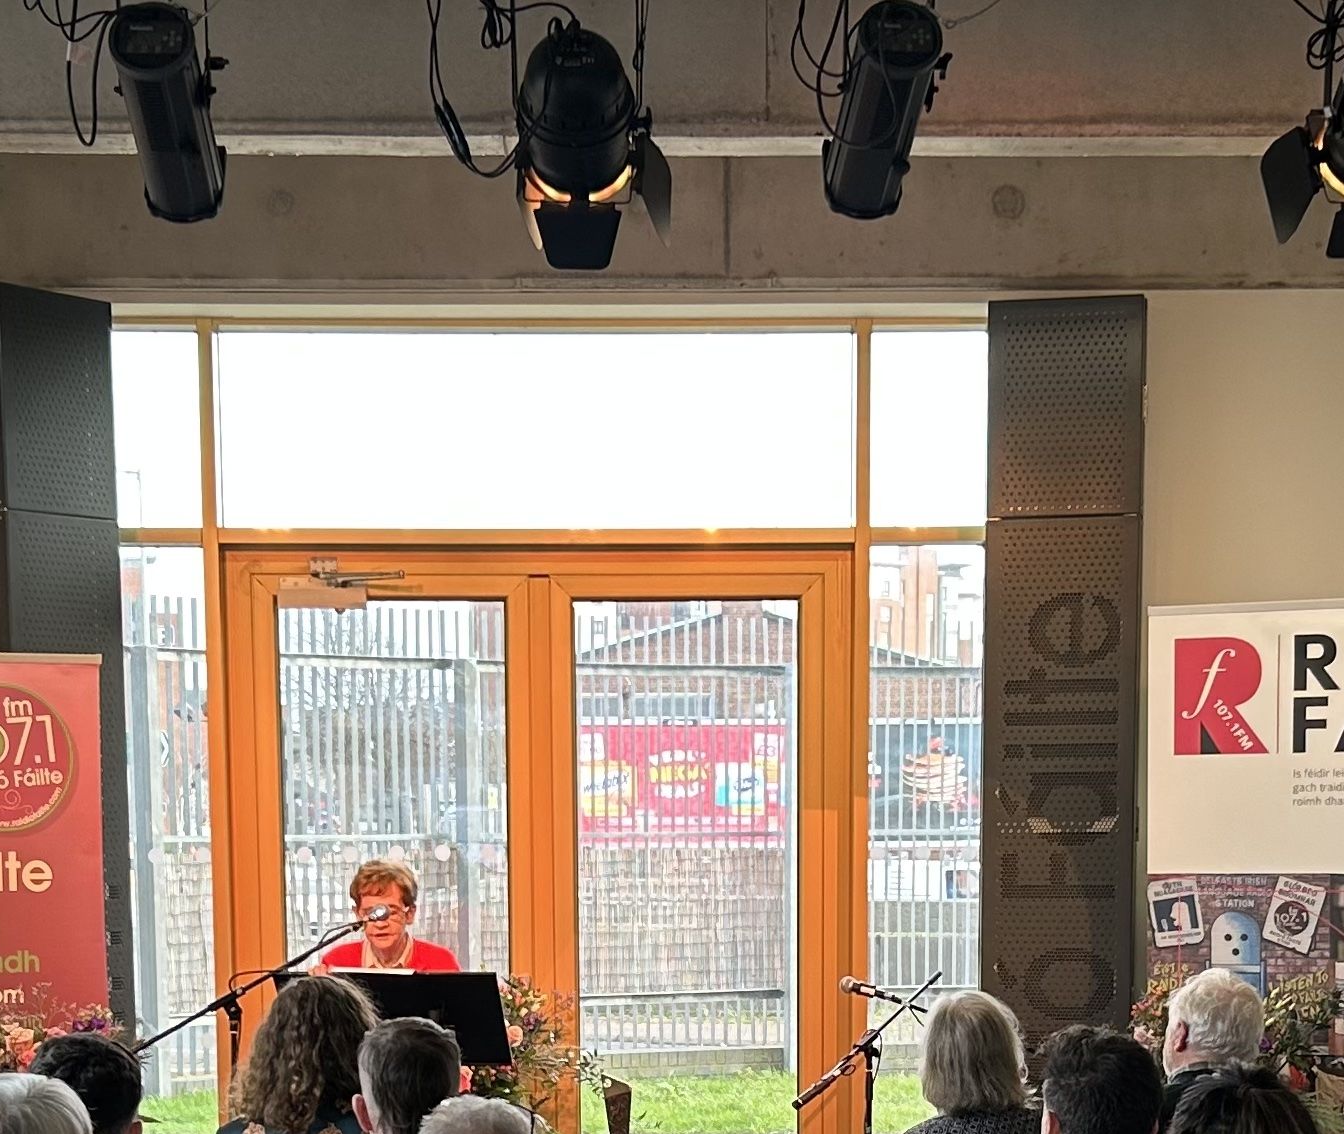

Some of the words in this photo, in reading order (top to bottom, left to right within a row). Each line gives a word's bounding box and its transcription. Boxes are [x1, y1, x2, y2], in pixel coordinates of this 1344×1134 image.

[3, 696, 33, 717] fm
[1212, 699, 1254, 751] 107.1FM
[13, 767, 64, 788] Fáilte
[1292, 768, 1302, 779] Is
[1292, 781, 1317, 795] gach
[1292, 795, 1322, 807] roimh
